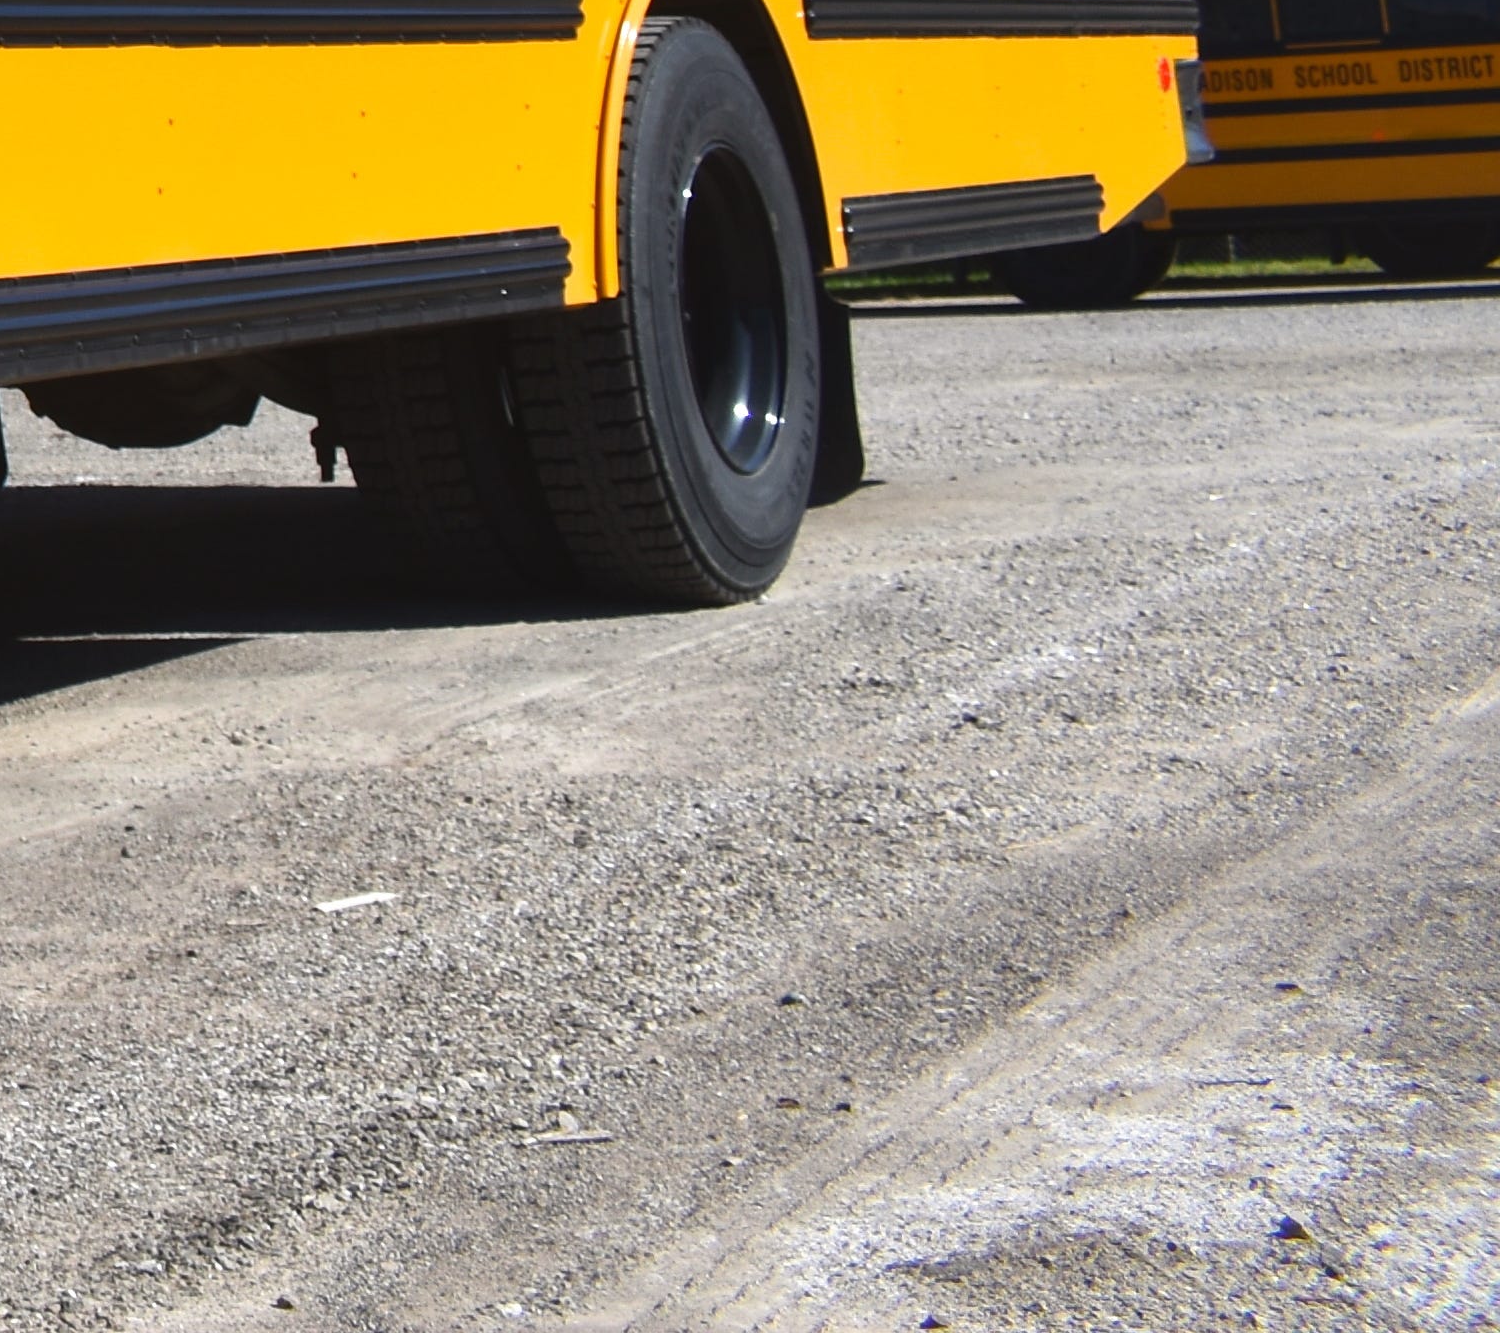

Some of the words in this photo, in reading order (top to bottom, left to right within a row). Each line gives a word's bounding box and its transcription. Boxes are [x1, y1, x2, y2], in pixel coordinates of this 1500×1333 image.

[1198, 66, 1273, 95] ADISON
[1294, 61, 1379, 90] SCHOOL
[1396, 53, 1495, 84] DISTRICT
